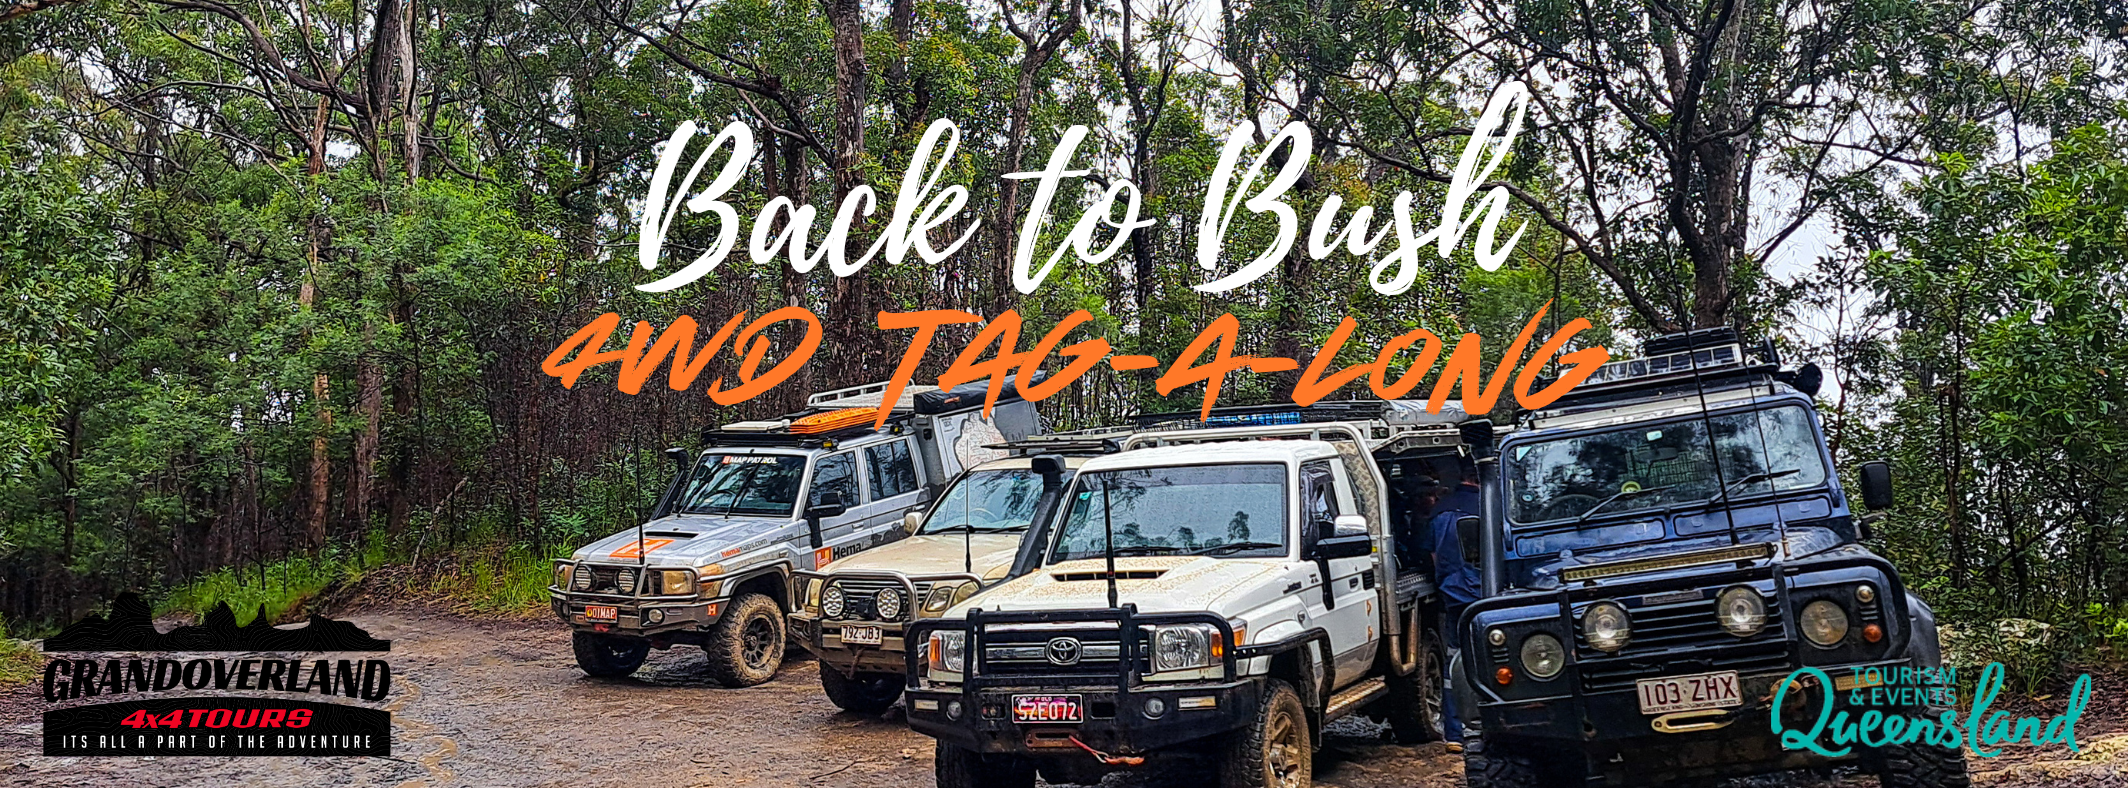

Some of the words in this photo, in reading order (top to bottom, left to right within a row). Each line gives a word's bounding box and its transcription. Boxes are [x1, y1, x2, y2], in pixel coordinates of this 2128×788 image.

[730, 456, 747, 465] MAP
[746, 456, 778, 464] PATROL
[832, 542, 862, 560] Hema
[1644, 682, 1681, 707] 103
[1689, 676, 1737, 702] ZHX
